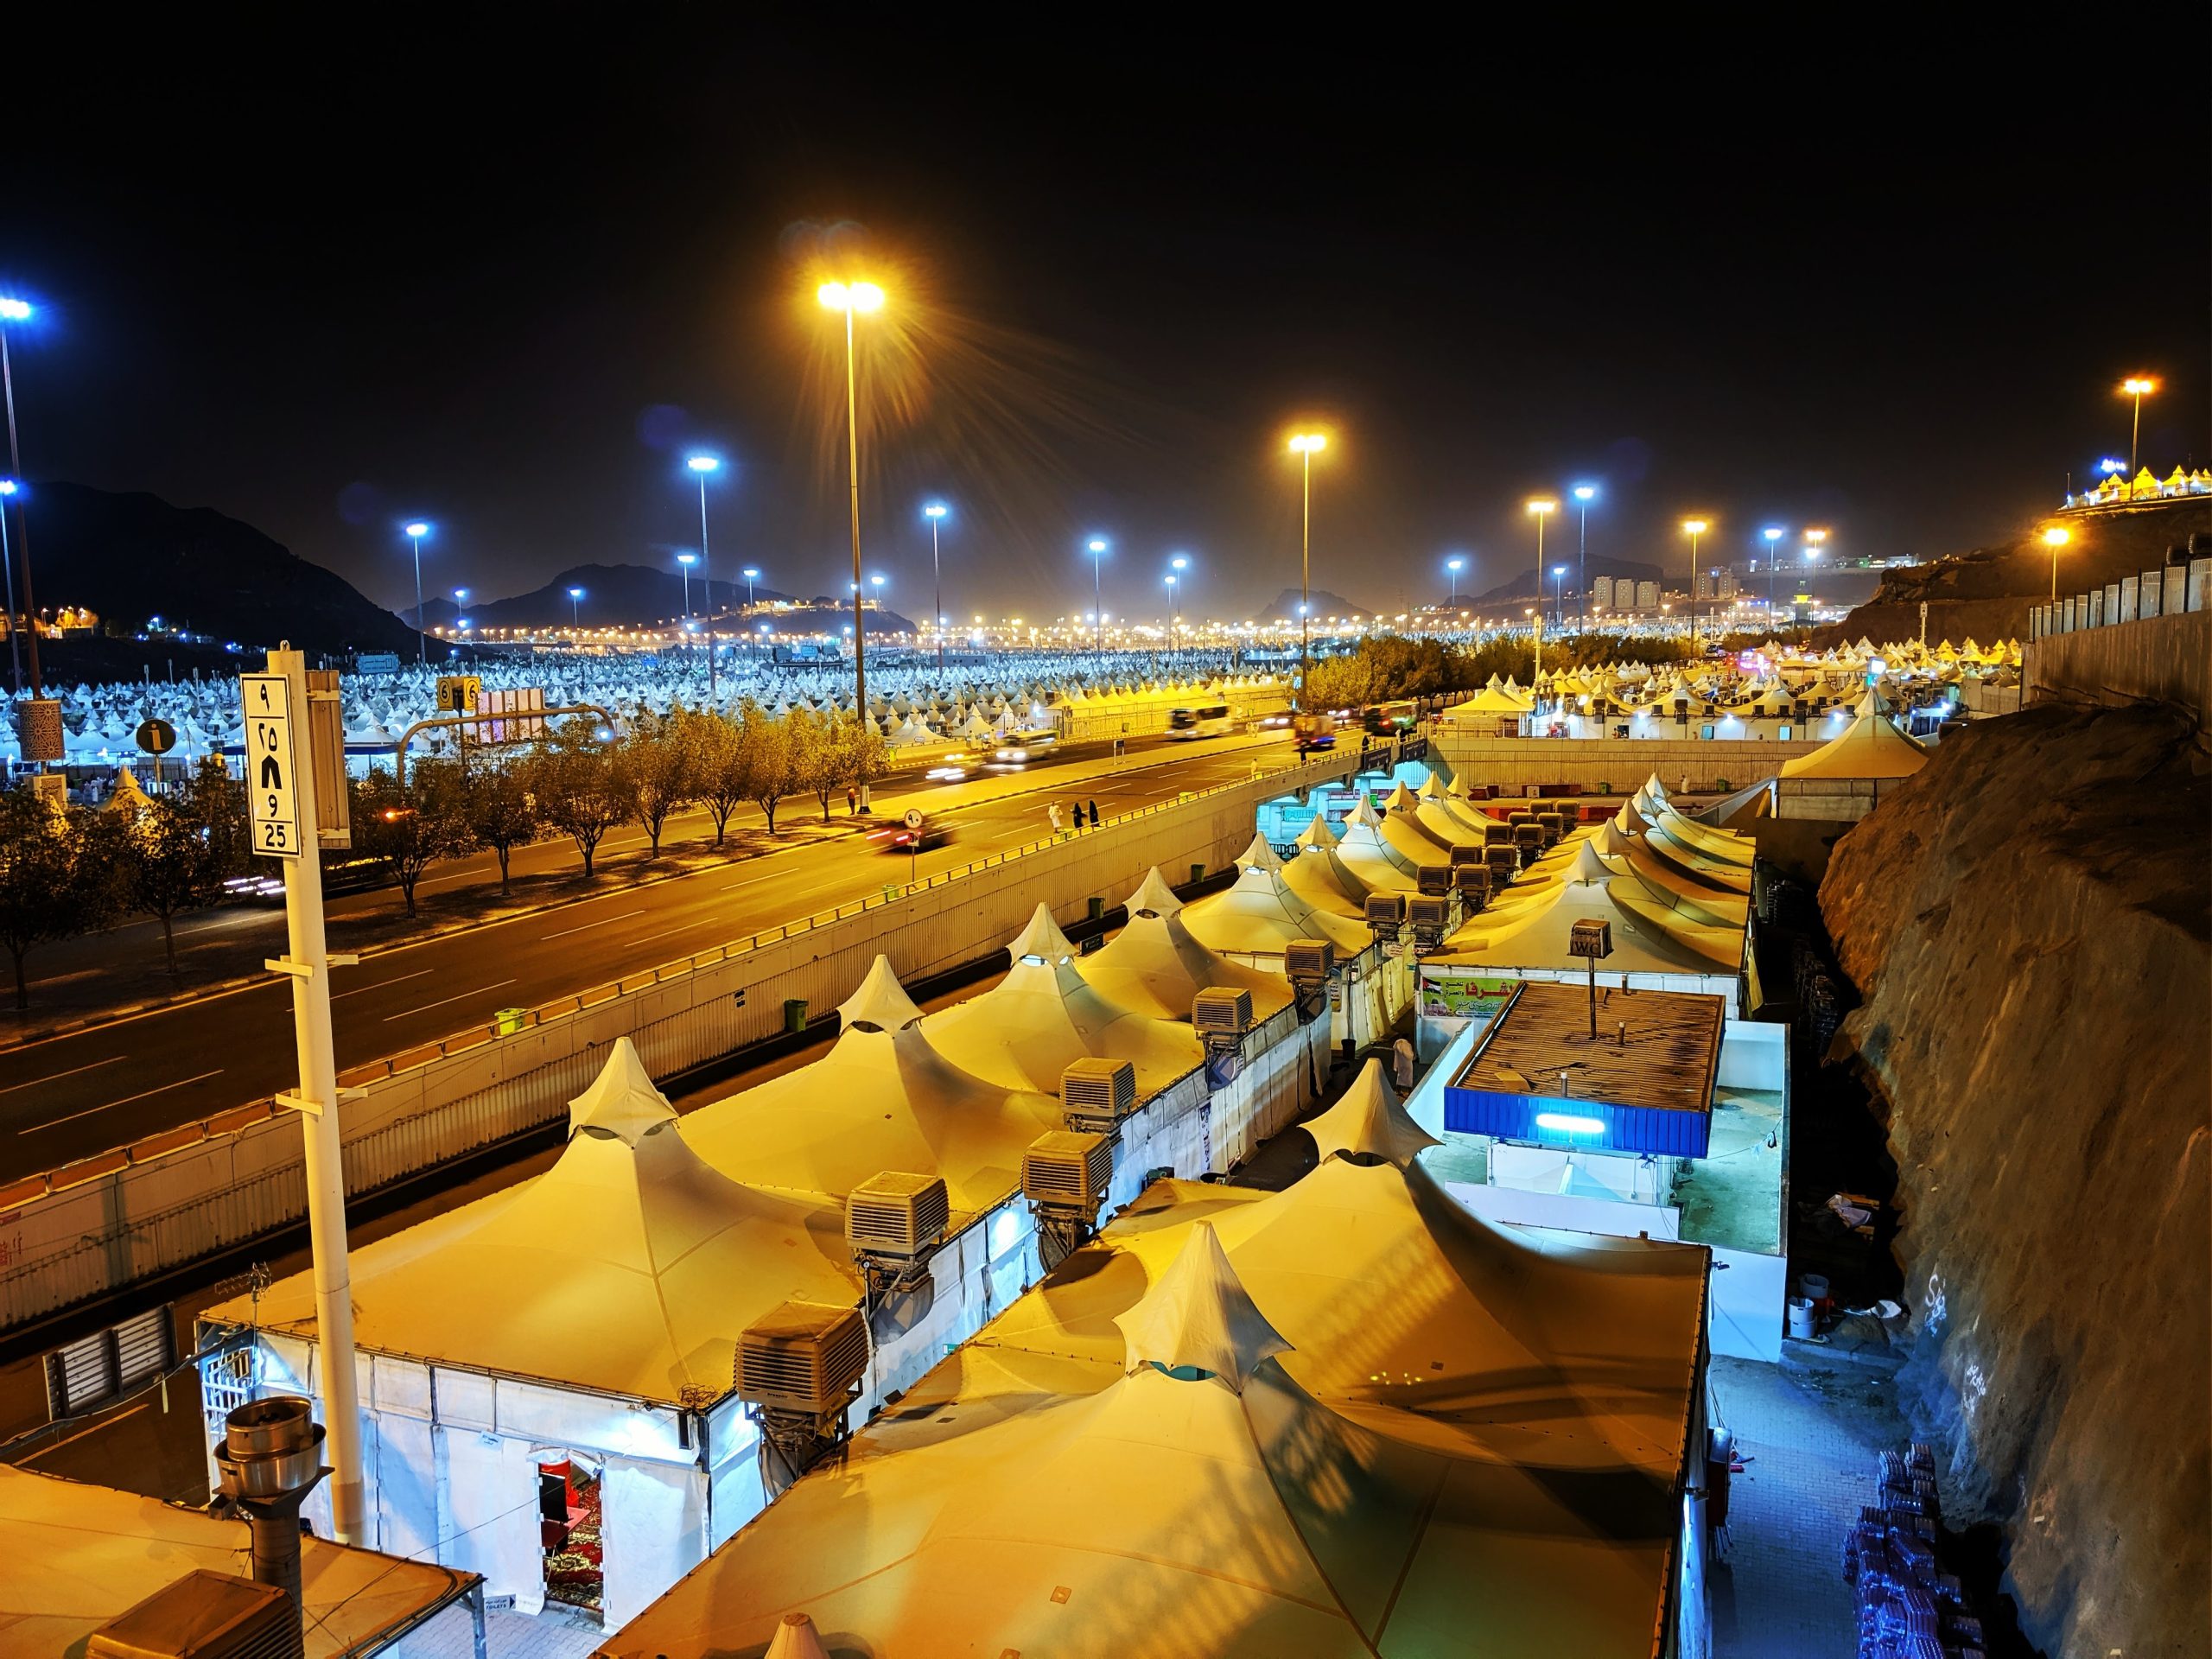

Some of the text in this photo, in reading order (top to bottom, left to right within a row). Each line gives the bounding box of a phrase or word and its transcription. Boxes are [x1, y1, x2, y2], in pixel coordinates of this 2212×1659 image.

[260, 683, 270, 712] ٩
[442, 684, 448, 699] 6
[258, 722, 277, 752] ٢٥
[268, 793, 278, 817] 9
[908, 814, 918, 823] ٩٠
[264, 823, 286, 848] 25
